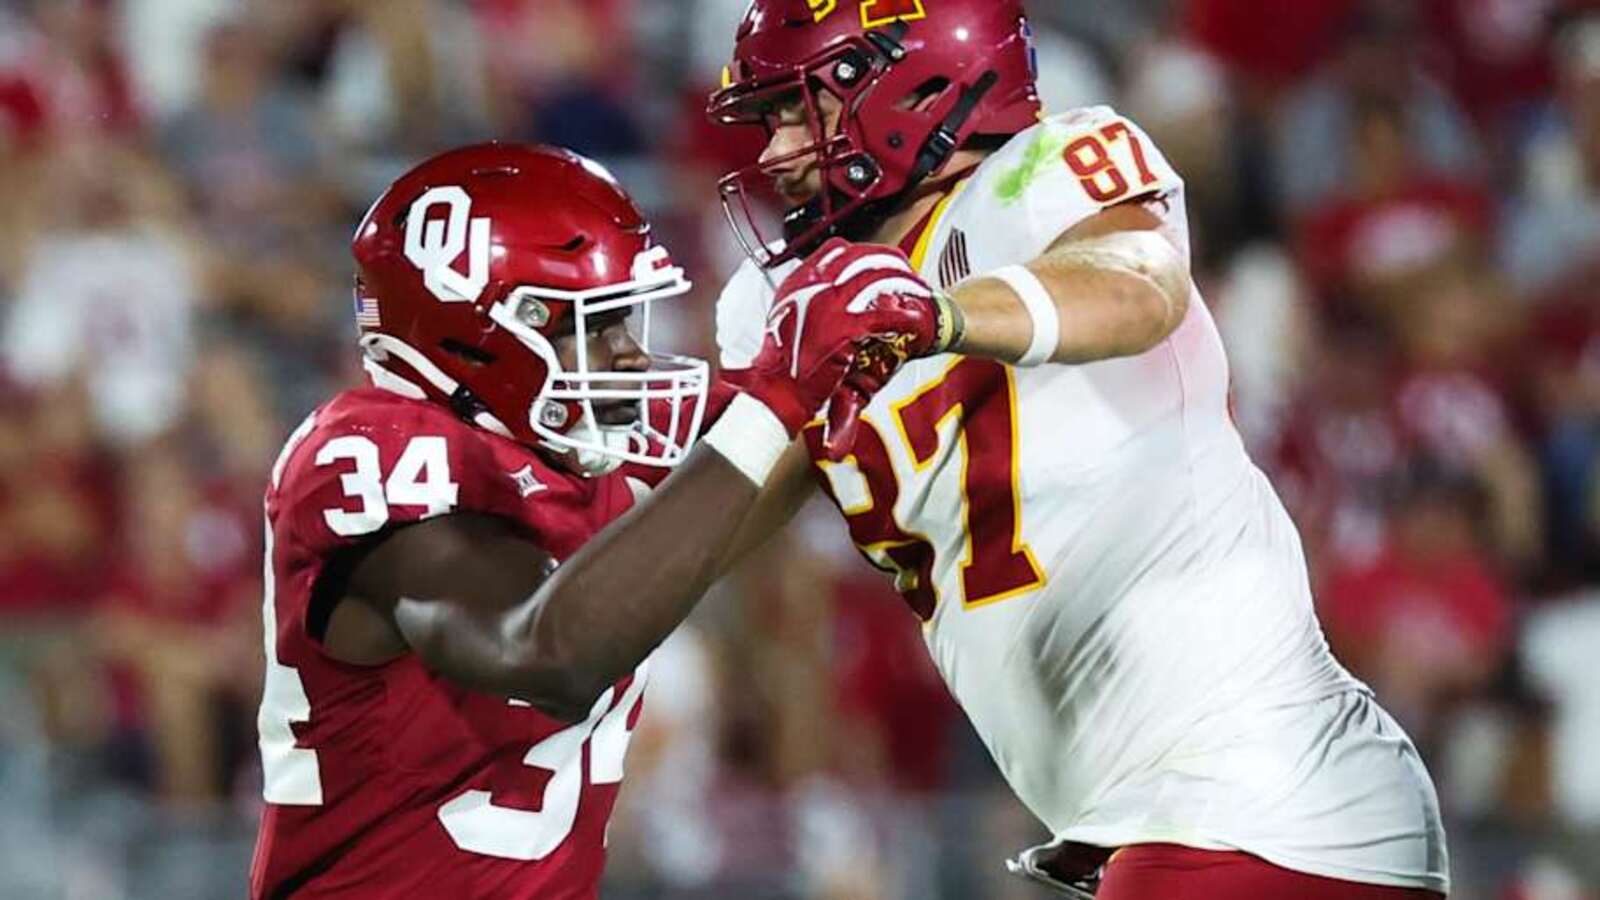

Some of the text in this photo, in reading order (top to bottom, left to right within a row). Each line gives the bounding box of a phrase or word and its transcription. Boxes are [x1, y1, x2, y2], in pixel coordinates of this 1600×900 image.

[1063, 121, 1158, 203] 87
[404, 185, 491, 302] OU
[315, 435, 459, 536] 34
[803, 352, 1047, 622] 87
